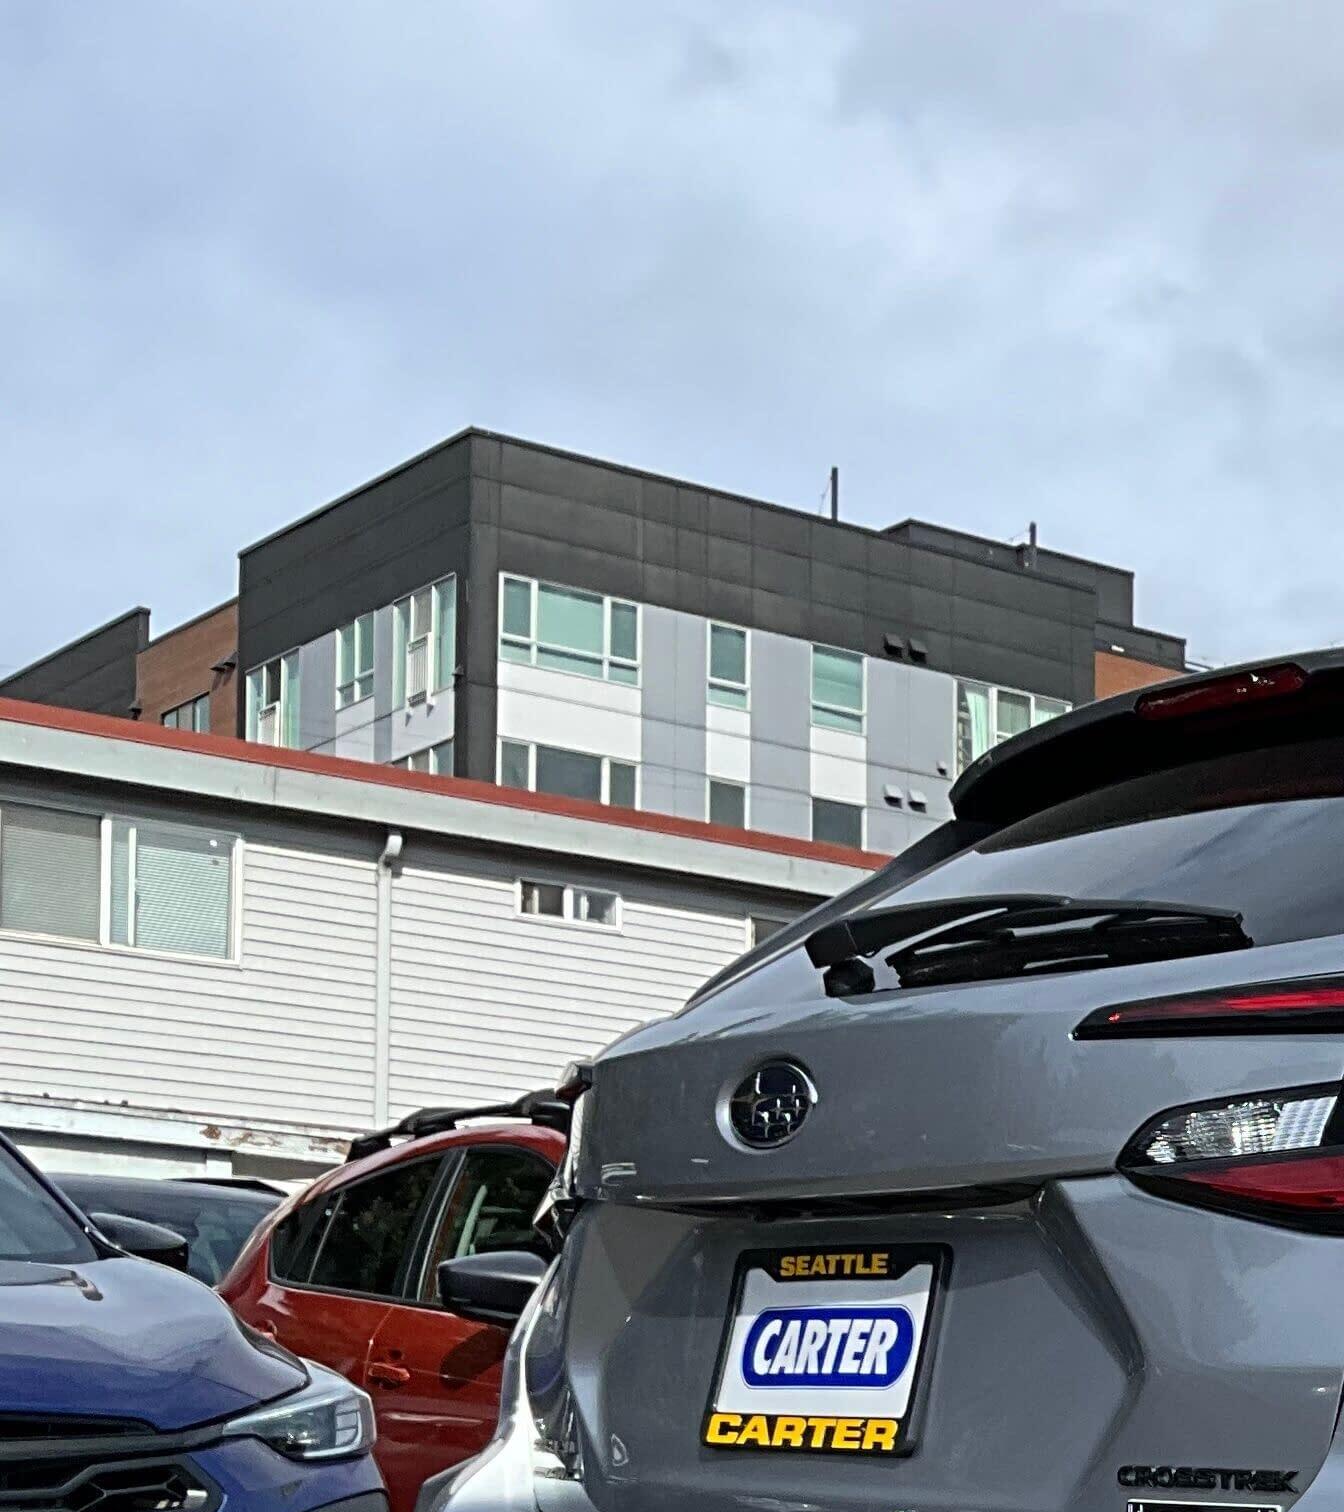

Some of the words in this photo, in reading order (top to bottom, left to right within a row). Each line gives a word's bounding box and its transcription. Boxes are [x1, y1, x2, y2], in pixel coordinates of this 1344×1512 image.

[780, 1253, 888, 1276] SEATTLE
[753, 1319, 899, 1375] CARTER
[706, 1413, 899, 1450] CARTER
[1117, 1466, 1300, 1492] CROSSTREK
